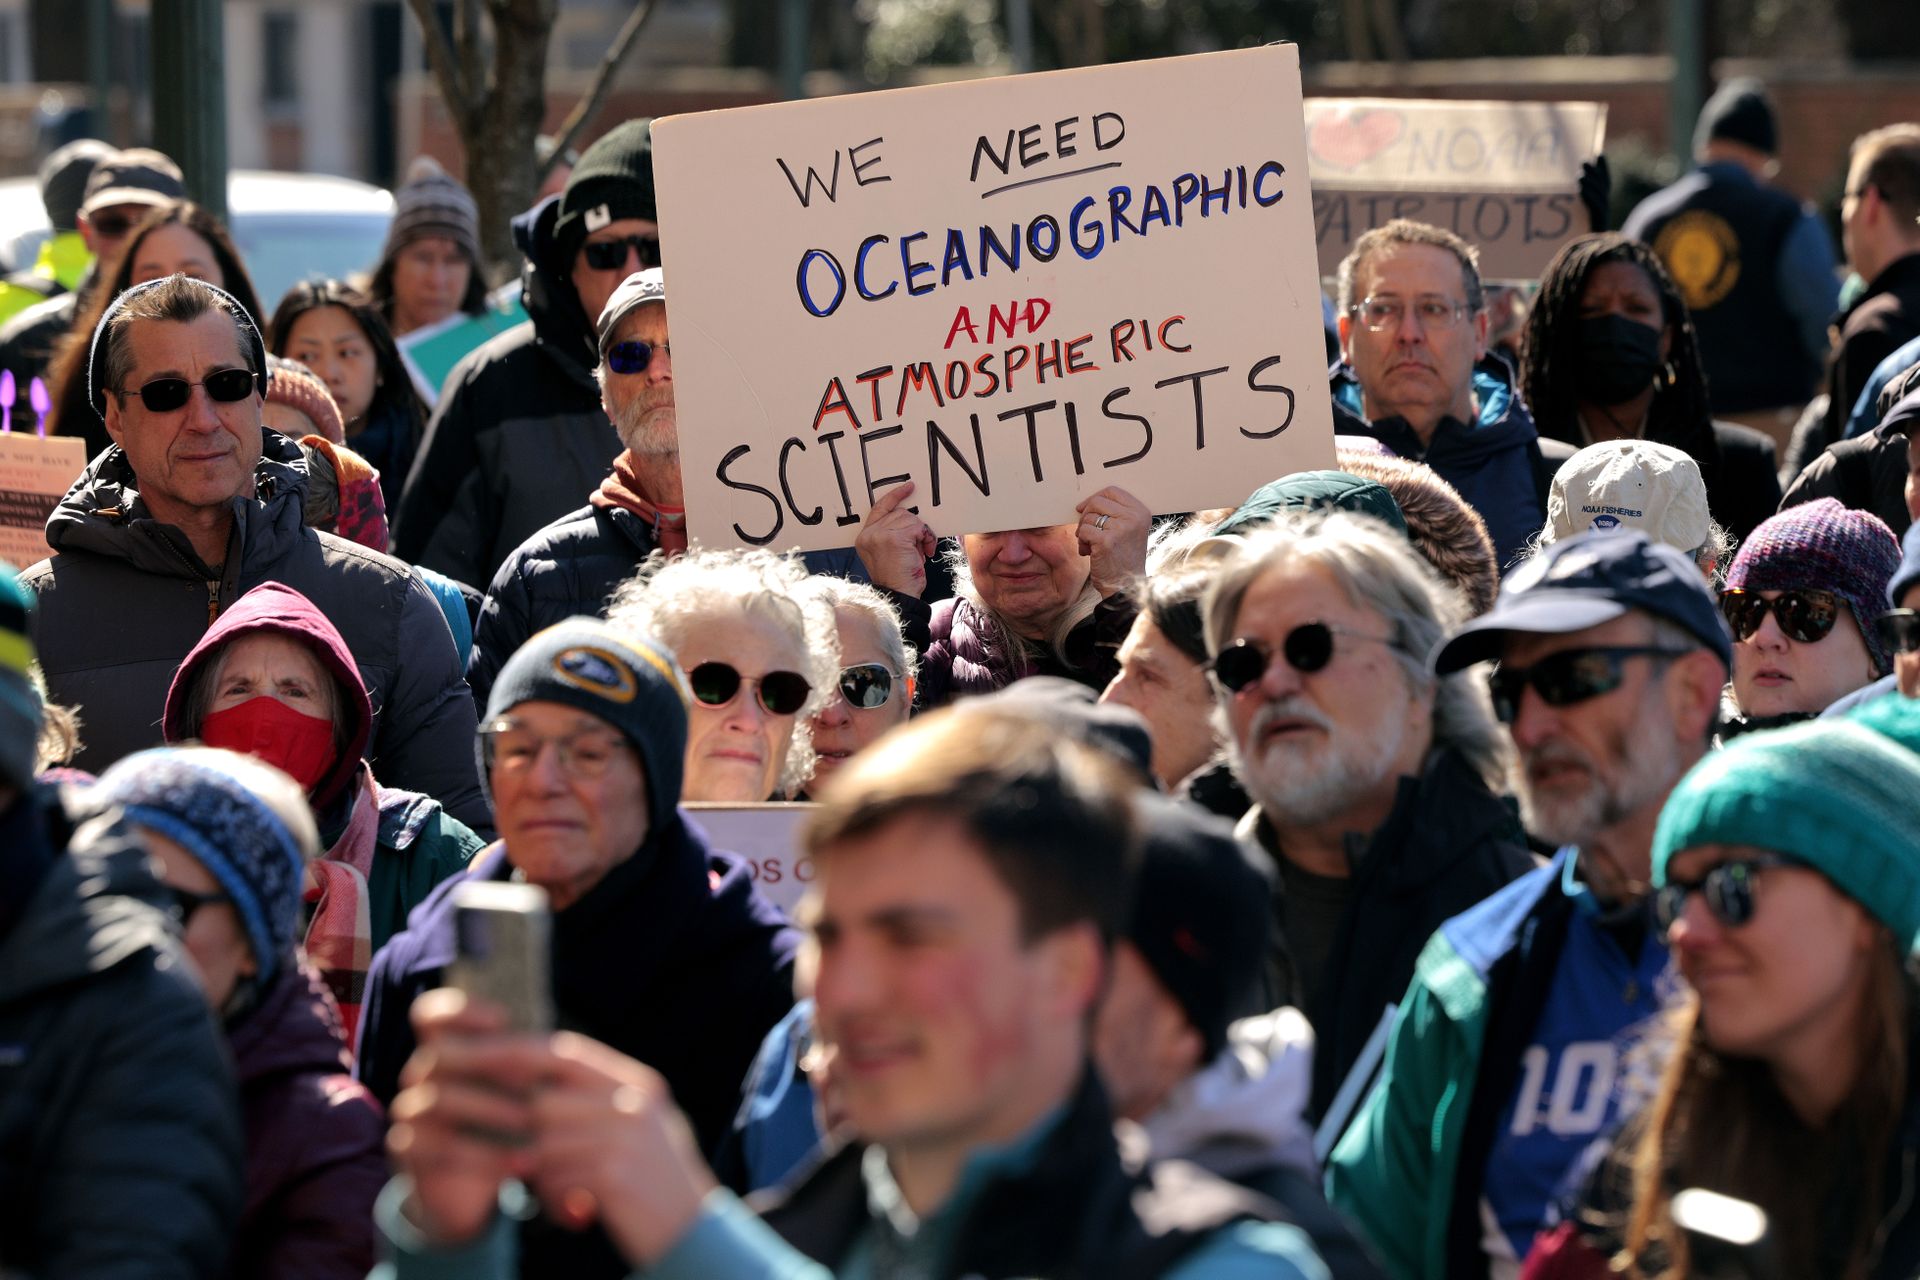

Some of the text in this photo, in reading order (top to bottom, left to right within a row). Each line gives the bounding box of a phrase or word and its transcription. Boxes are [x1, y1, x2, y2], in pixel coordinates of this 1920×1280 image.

[776, 112, 1126, 207] WE NEED
[796, 161, 1285, 318] OCEANOGRAPHIC
[944, 298, 1052, 349] AND
[716, 355, 1296, 546] SCIENTISTS
[1582, 505, 1642, 517] NOAA FISHERIES
